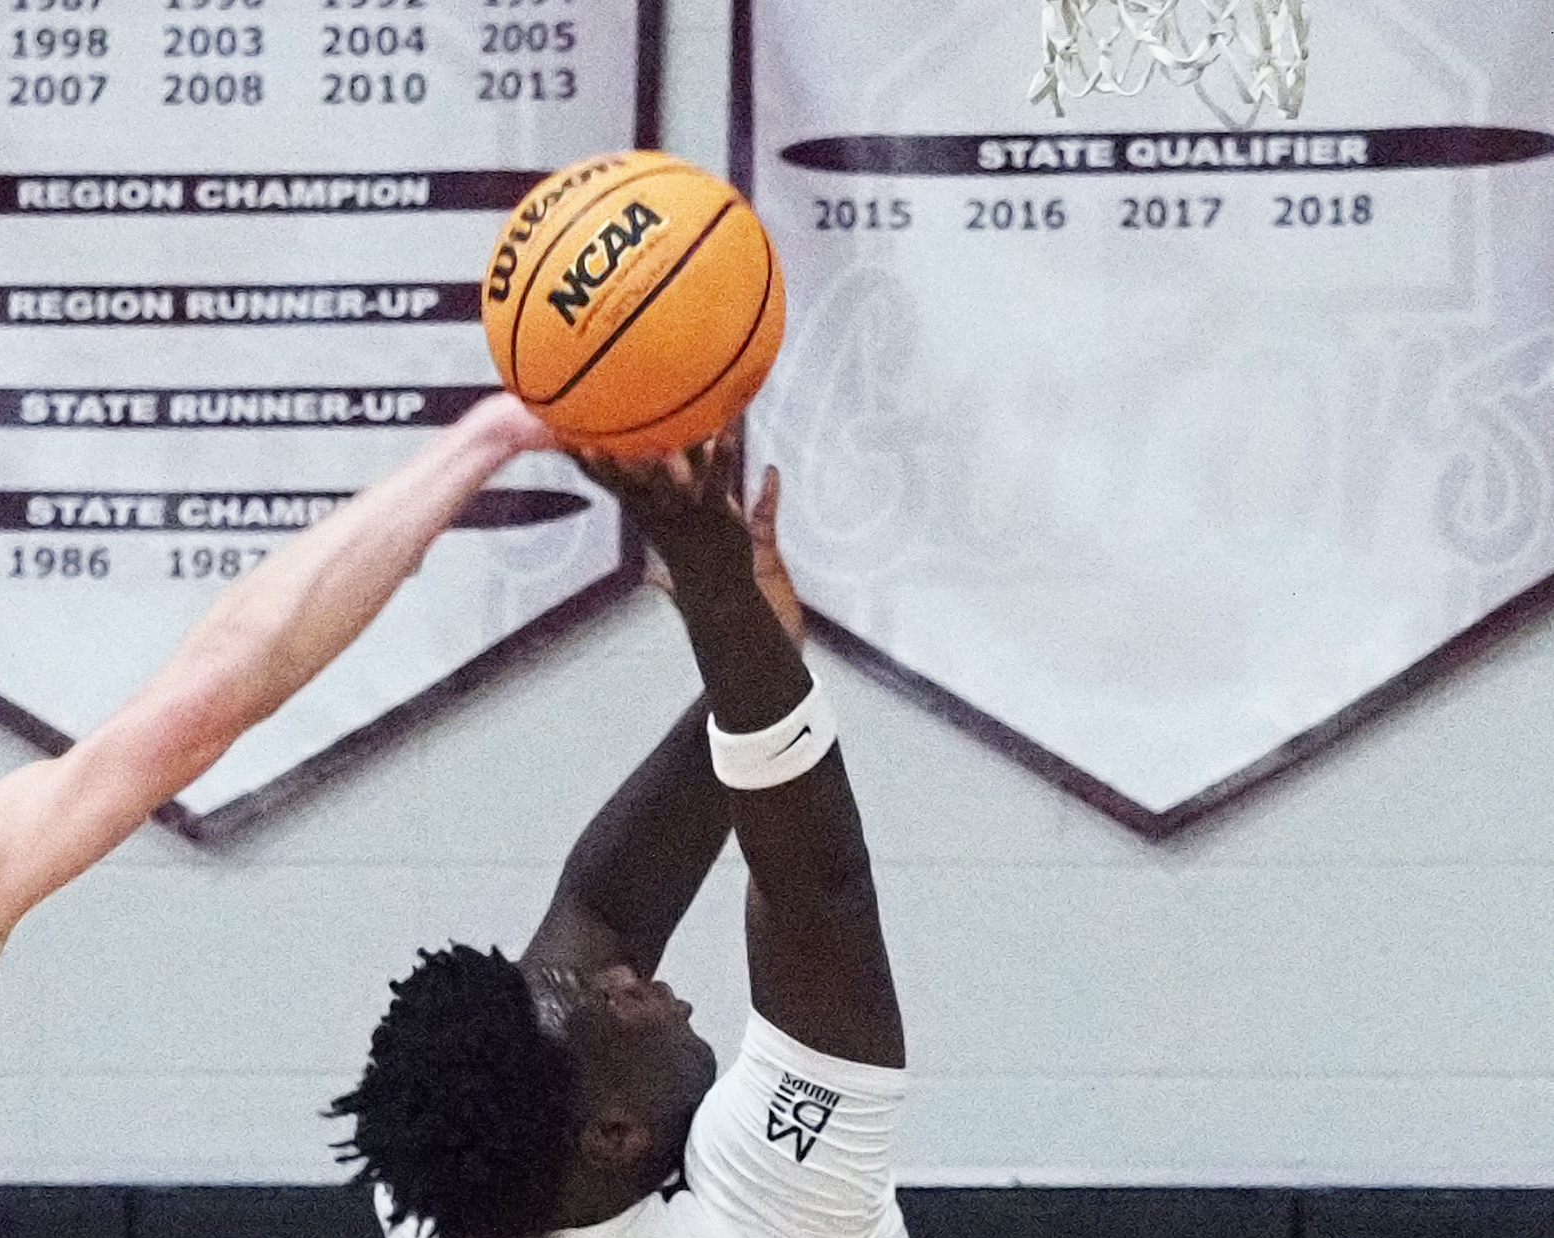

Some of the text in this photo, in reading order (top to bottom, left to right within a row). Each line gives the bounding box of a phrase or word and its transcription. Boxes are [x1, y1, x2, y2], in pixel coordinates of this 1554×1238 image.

[12, 25, 110, 60] 1998
[162, 24, 265, 59] 2003
[322, 23, 428, 58] 2004
[480, 19, 579, 55] 2005
[7, 72, 109, 108] 2007
[162, 71, 265, 107] 2008
[321, 71, 429, 106] 2010
[477, 65, 580, 103] 2013
[977, 134, 1370, 170] STATE QUALIFIER
[17, 178, 430, 210] REGION CHAMPION
[810, 192, 1374, 234] 2015 2016 2017 2018
[548, 201, 662, 327] NCAA
[8, 289, 440, 321] REGION RUNNER-UP
[20, 393, 426, 424] STATE RUNNER-UP
[26, 496, 338, 527] STATE CHAMP
[8, 545, 112, 580] 1986
